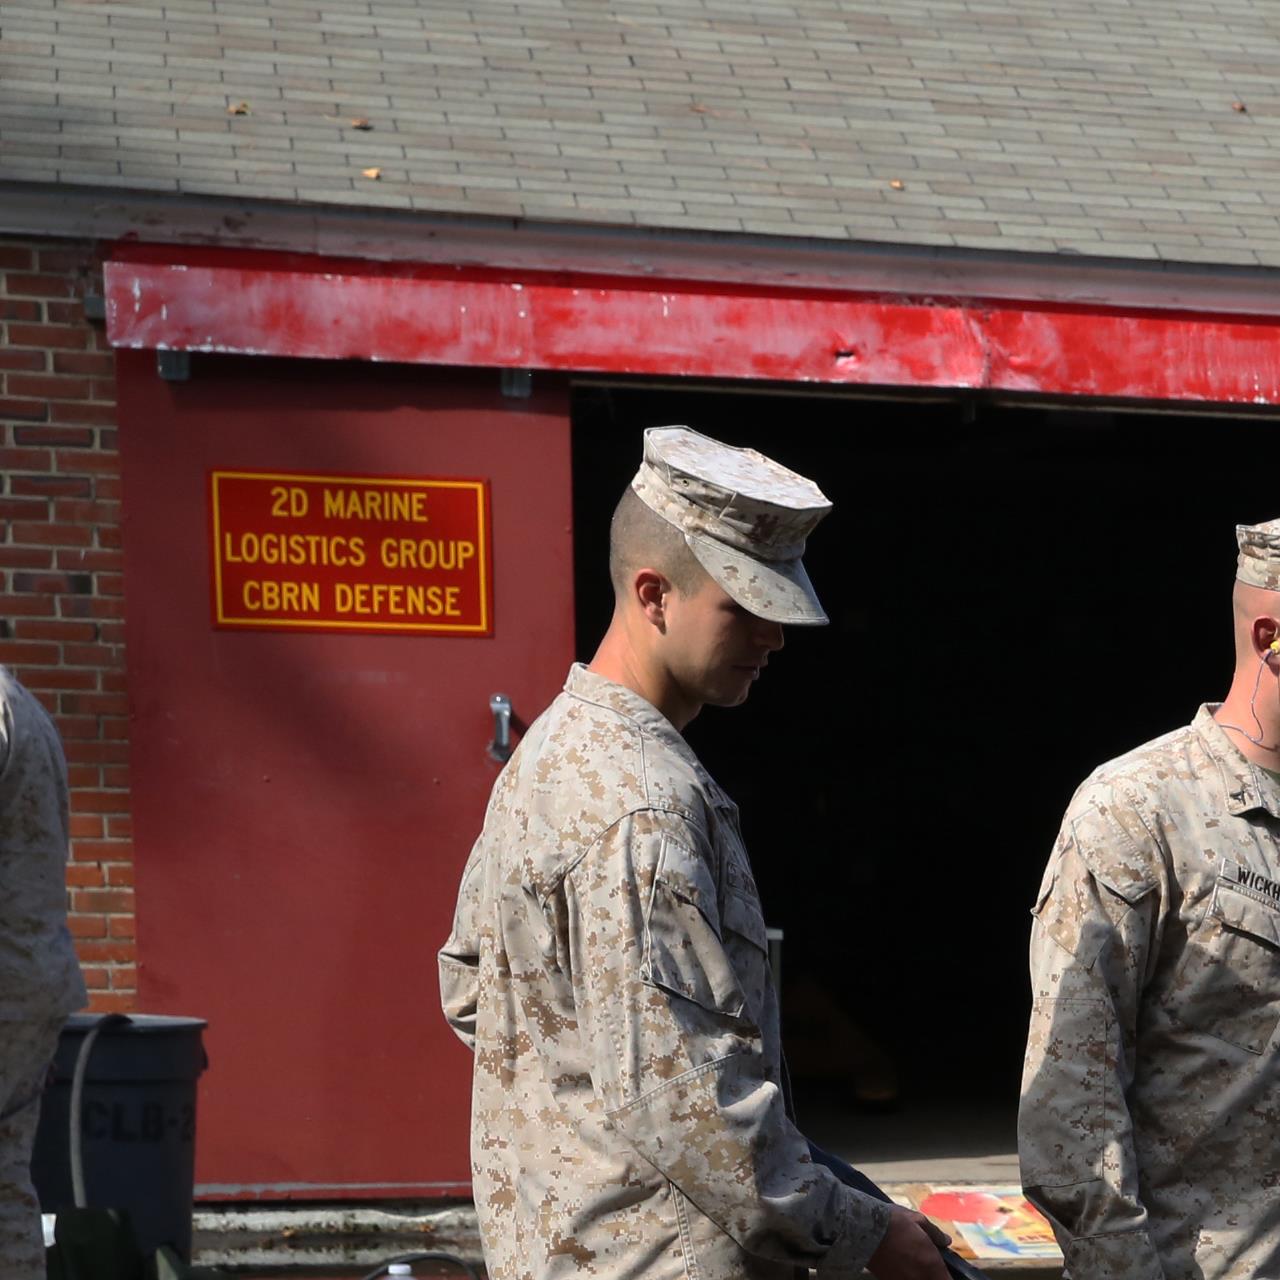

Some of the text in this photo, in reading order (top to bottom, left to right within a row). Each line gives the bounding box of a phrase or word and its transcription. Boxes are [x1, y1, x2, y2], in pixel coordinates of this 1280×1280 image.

[269, 487, 428, 522] 2D MARINE
[224, 532, 475, 570] LOGISTICS GROUP
[242, 580, 462, 616] CBRN DEFENSE
